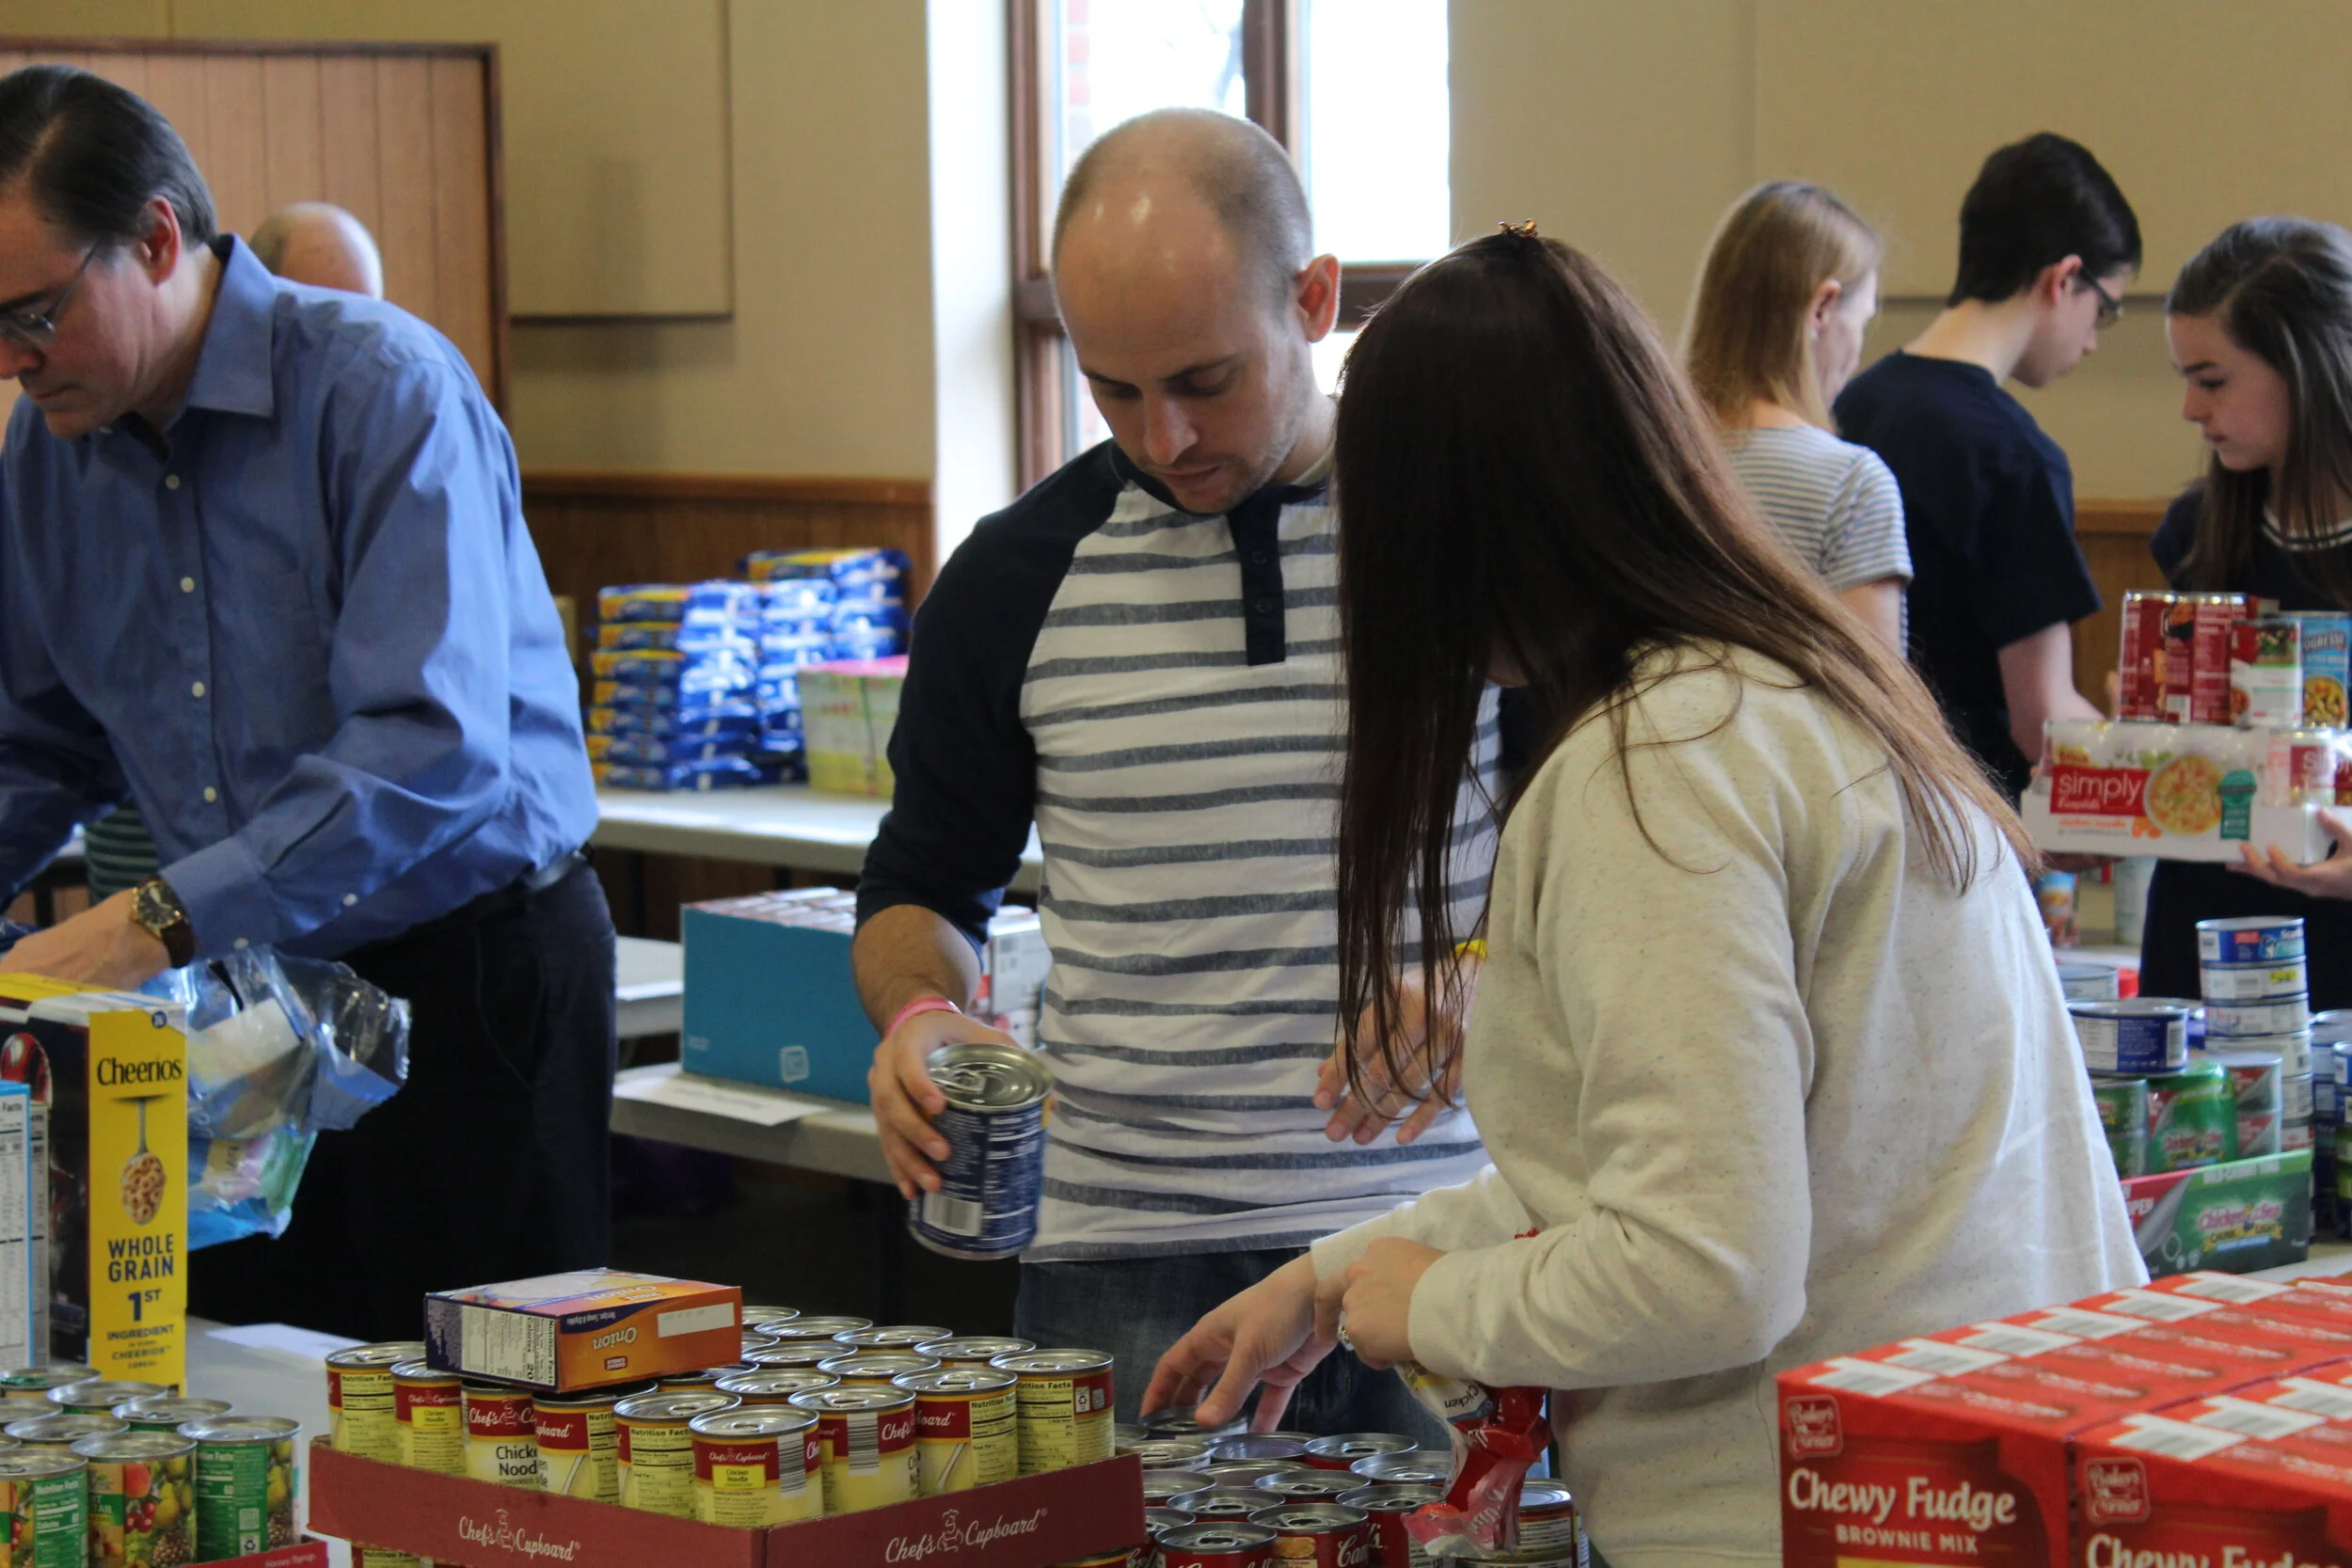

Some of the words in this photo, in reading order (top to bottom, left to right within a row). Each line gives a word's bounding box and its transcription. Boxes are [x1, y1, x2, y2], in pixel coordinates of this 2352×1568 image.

[2058, 770, 2142, 806] simply
[97, 1055, 183, 1086] Cheerios
[108, 1234, 174, 1259] WHOLE
[108, 1256, 174, 1282] GRAIN
[128, 1289, 162, 1322] 1ST
[107, 1324, 175, 1340] INGREDIENT
[592, 1326, 637, 1351] Onion
[1048, 1381, 1072, 1389] Facts
[469, 1407, 501, 1427] Chef's
[972, 1398, 1004, 1409] Nutrition
[1788, 1467, 1897, 1525] Chewy
[1906, 1477, 2016, 1532] Fudge
[458, 1515, 498, 1547] Chef's
[1836, 1524, 1932, 1551] BROWNIE
[1938, 1532, 1979, 1556] MIX
[885, 1533, 937, 1564] Chef's
